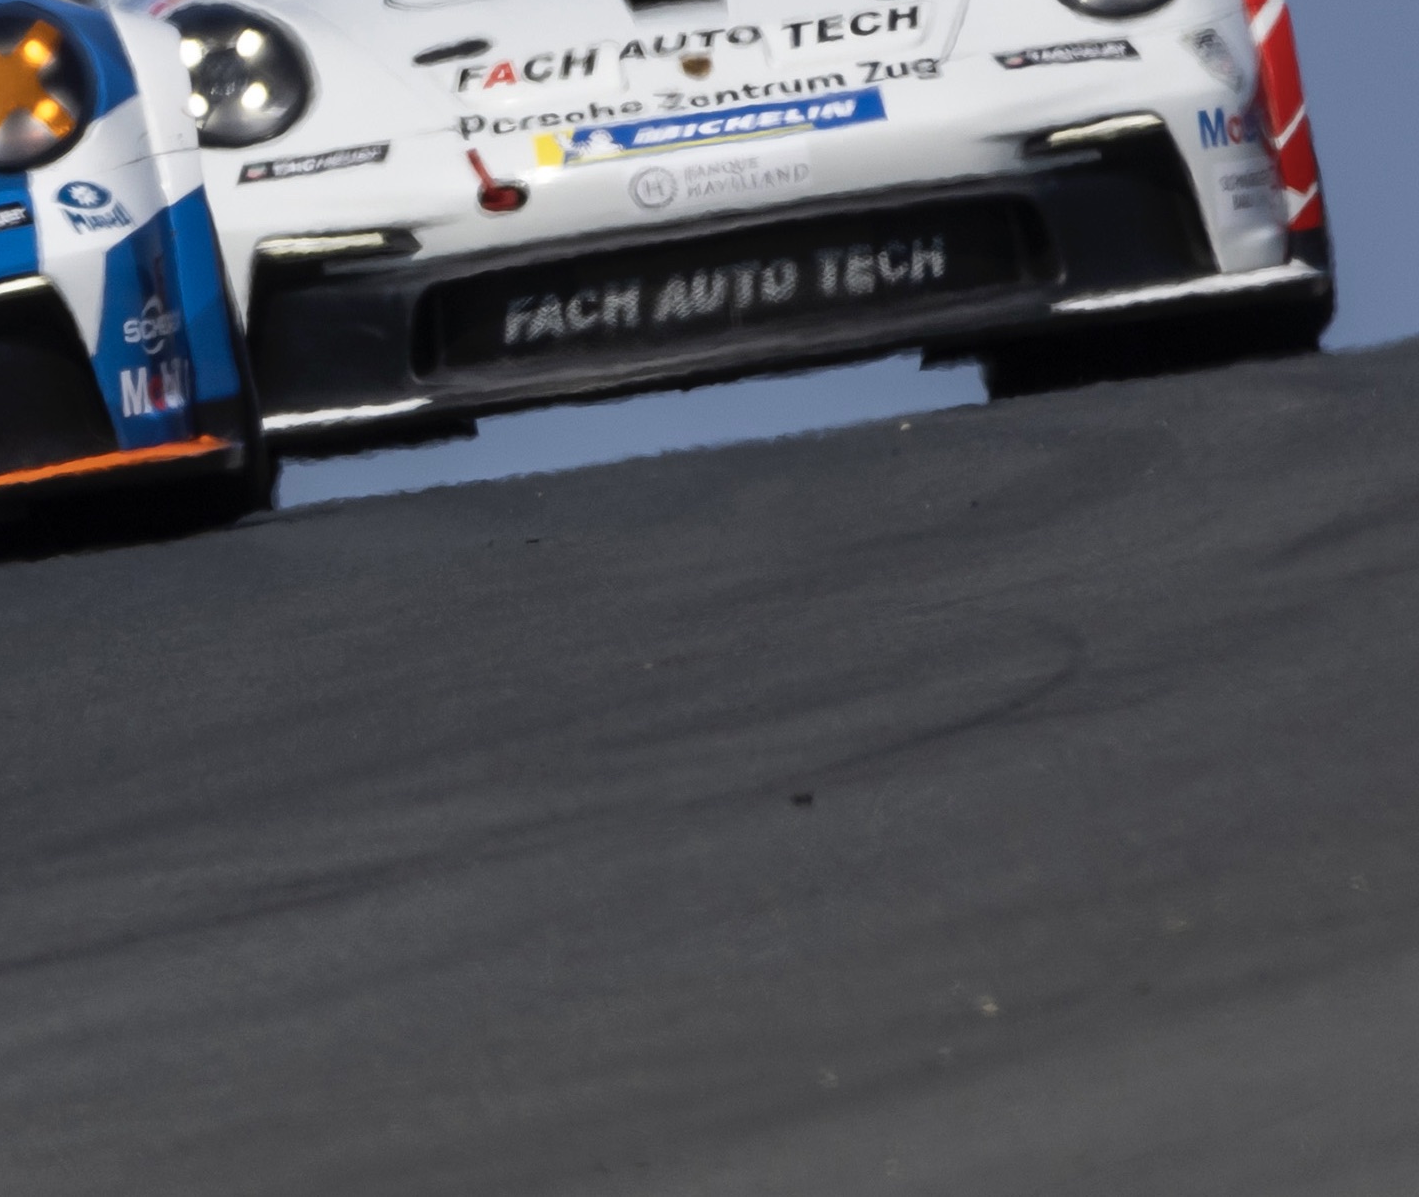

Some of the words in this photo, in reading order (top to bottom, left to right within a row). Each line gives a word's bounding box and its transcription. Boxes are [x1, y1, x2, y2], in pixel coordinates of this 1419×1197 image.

[458, 47, 600, 92] FACH
[620, 23, 761, 62] AUTO
[782, 4, 921, 49] TECH
[460, 94, 643, 140] Porsche
[655, 74, 847, 111] Zentrum
[861, 57, 941, 85] Zug
[632, 97, 858, 146] MICHELIN
[504, 280, 641, 345] FACH
[654, 257, 799, 323] AUTO
[814, 237, 946, 297] TECH
